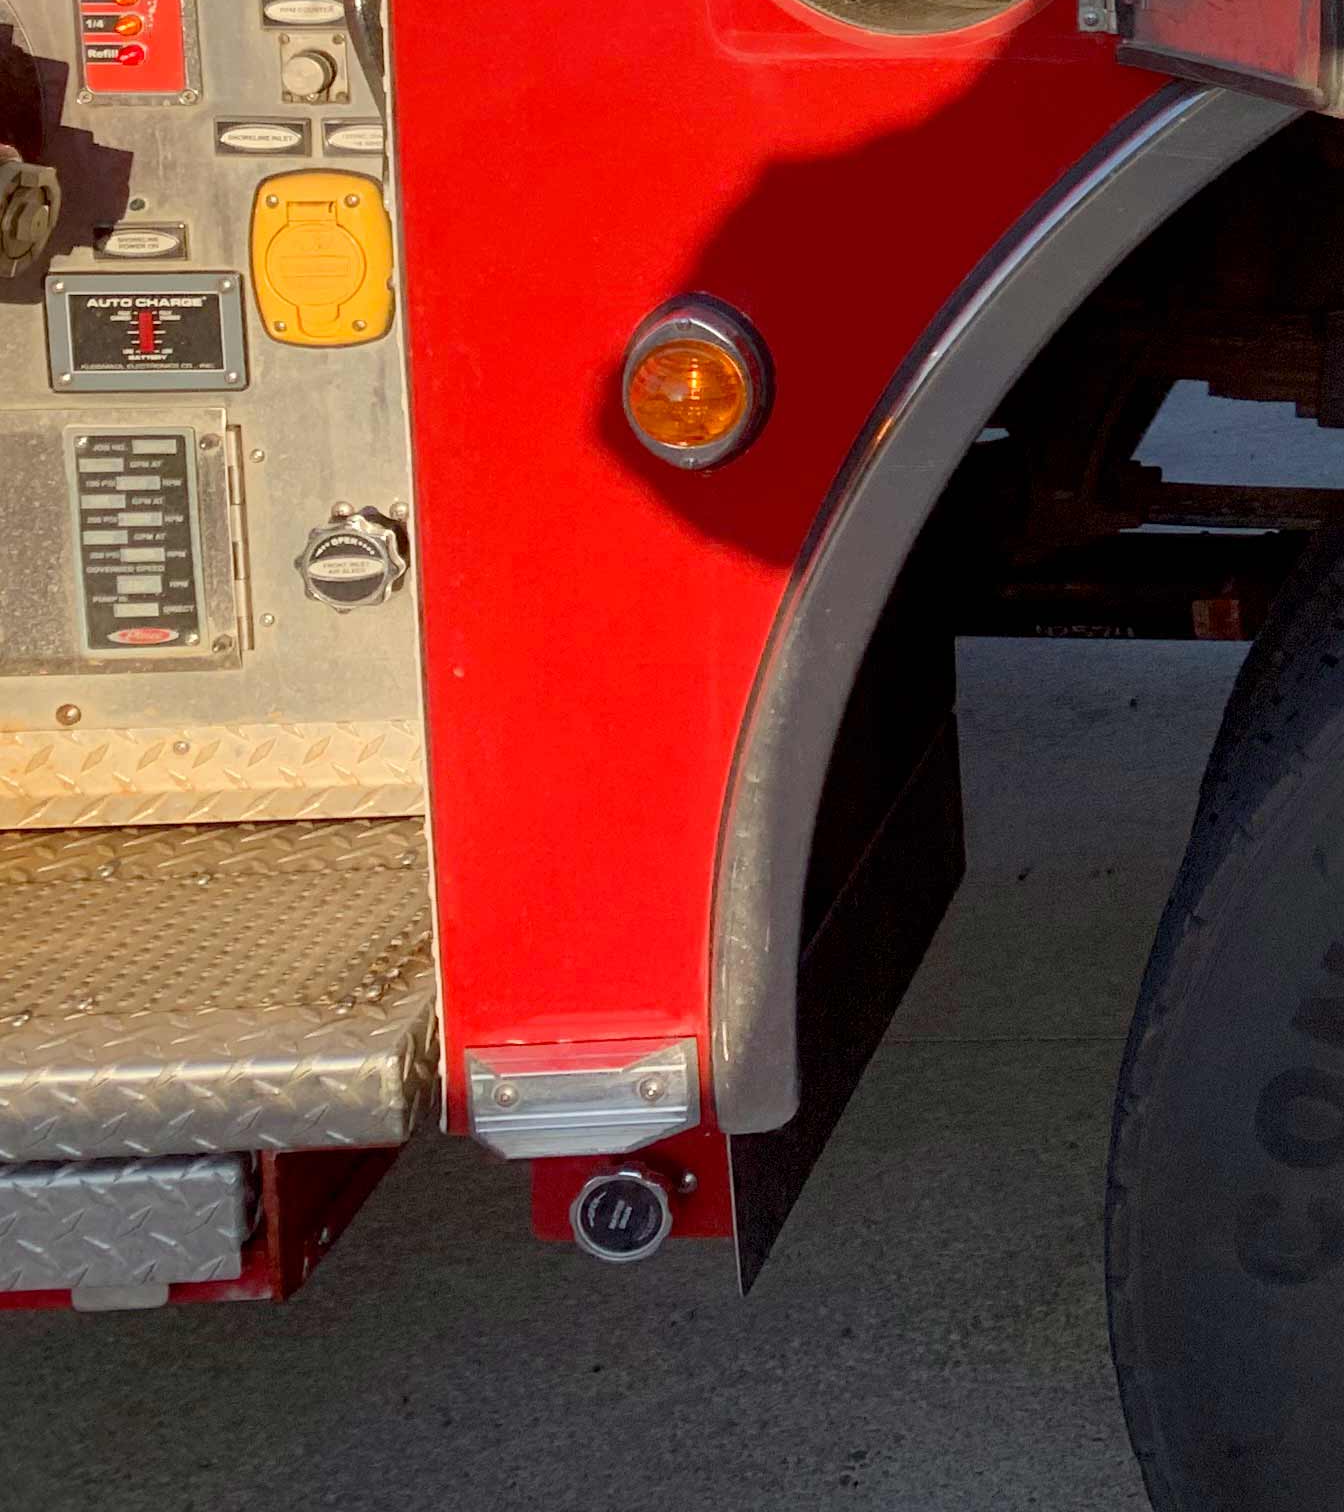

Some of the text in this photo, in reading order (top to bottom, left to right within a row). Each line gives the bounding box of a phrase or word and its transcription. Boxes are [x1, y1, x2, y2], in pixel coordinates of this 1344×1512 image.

[85, 18, 104, 30] 1/4
[87, 47, 119, 60] Refill
[86, 297, 203, 308] AUTO CHARGE
[330, 536, 359, 547] OPEN
